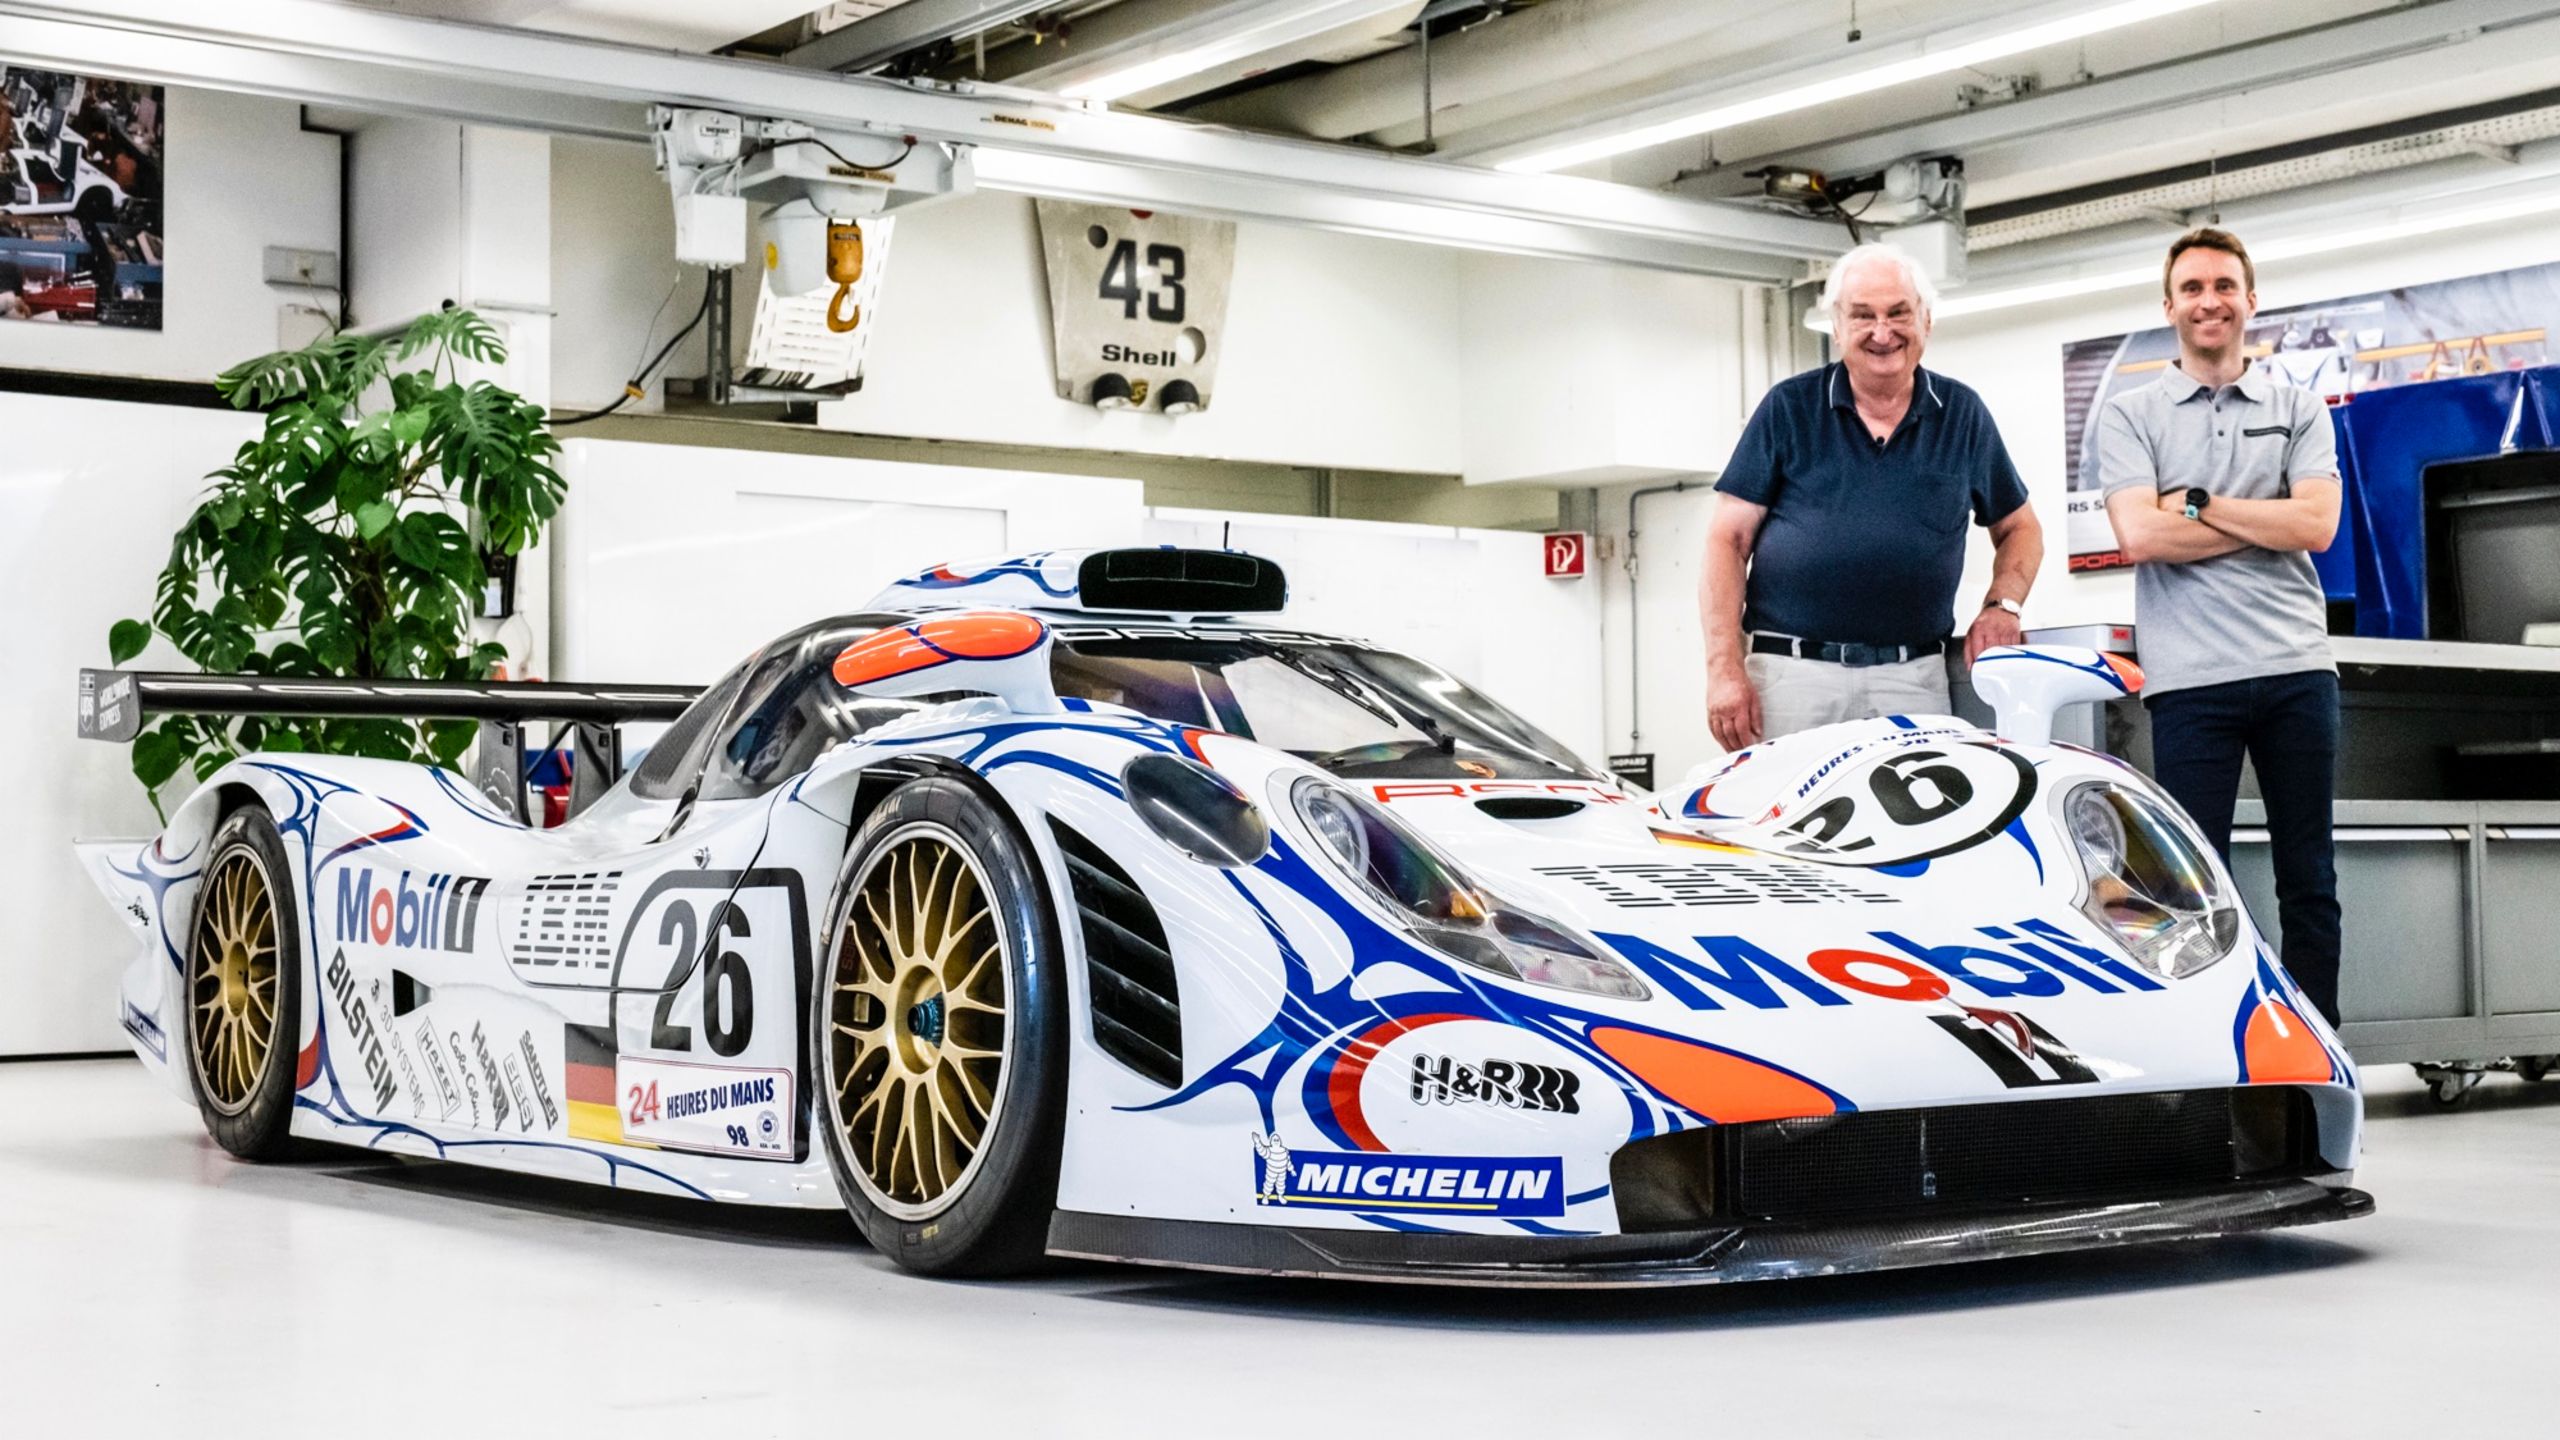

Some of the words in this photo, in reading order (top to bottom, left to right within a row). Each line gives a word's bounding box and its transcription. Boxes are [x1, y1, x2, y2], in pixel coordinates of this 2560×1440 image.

[993, 114, 1028, 126] DEMAG
[828, 166, 866, 179] DEMAG
[1099, 238, 1185, 325] 43
[1101, 343, 1177, 368] Shell
[1772, 750, 1974, 854] 26
[1797, 744, 1863, 799] HEURES
[336, 867, 452, 950] Mobil
[512, 870, 623, 970] IBM
[1531, 863, 1903, 908] IBM
[651, 899, 754, 1058] 26
[1589, 918, 2169, 1011] Mobil
[327, 945, 398, 1116] BILSTEIN
[421, 1031, 458, 1107] HAZET
[391, 1031, 426, 1120] SYSTEMS
[503, 1053, 535, 1133] BBS
[521, 1029, 559, 1129] SANDTLER
[629, 1079, 662, 1128] 24
[666, 1086, 708, 1120] HEURES
[710, 1085, 728, 1111] DU
[730, 1076, 775, 1108] MANS
[726, 1124, 750, 1148] 98
[1297, 1162, 1552, 1201] MICHELIN
